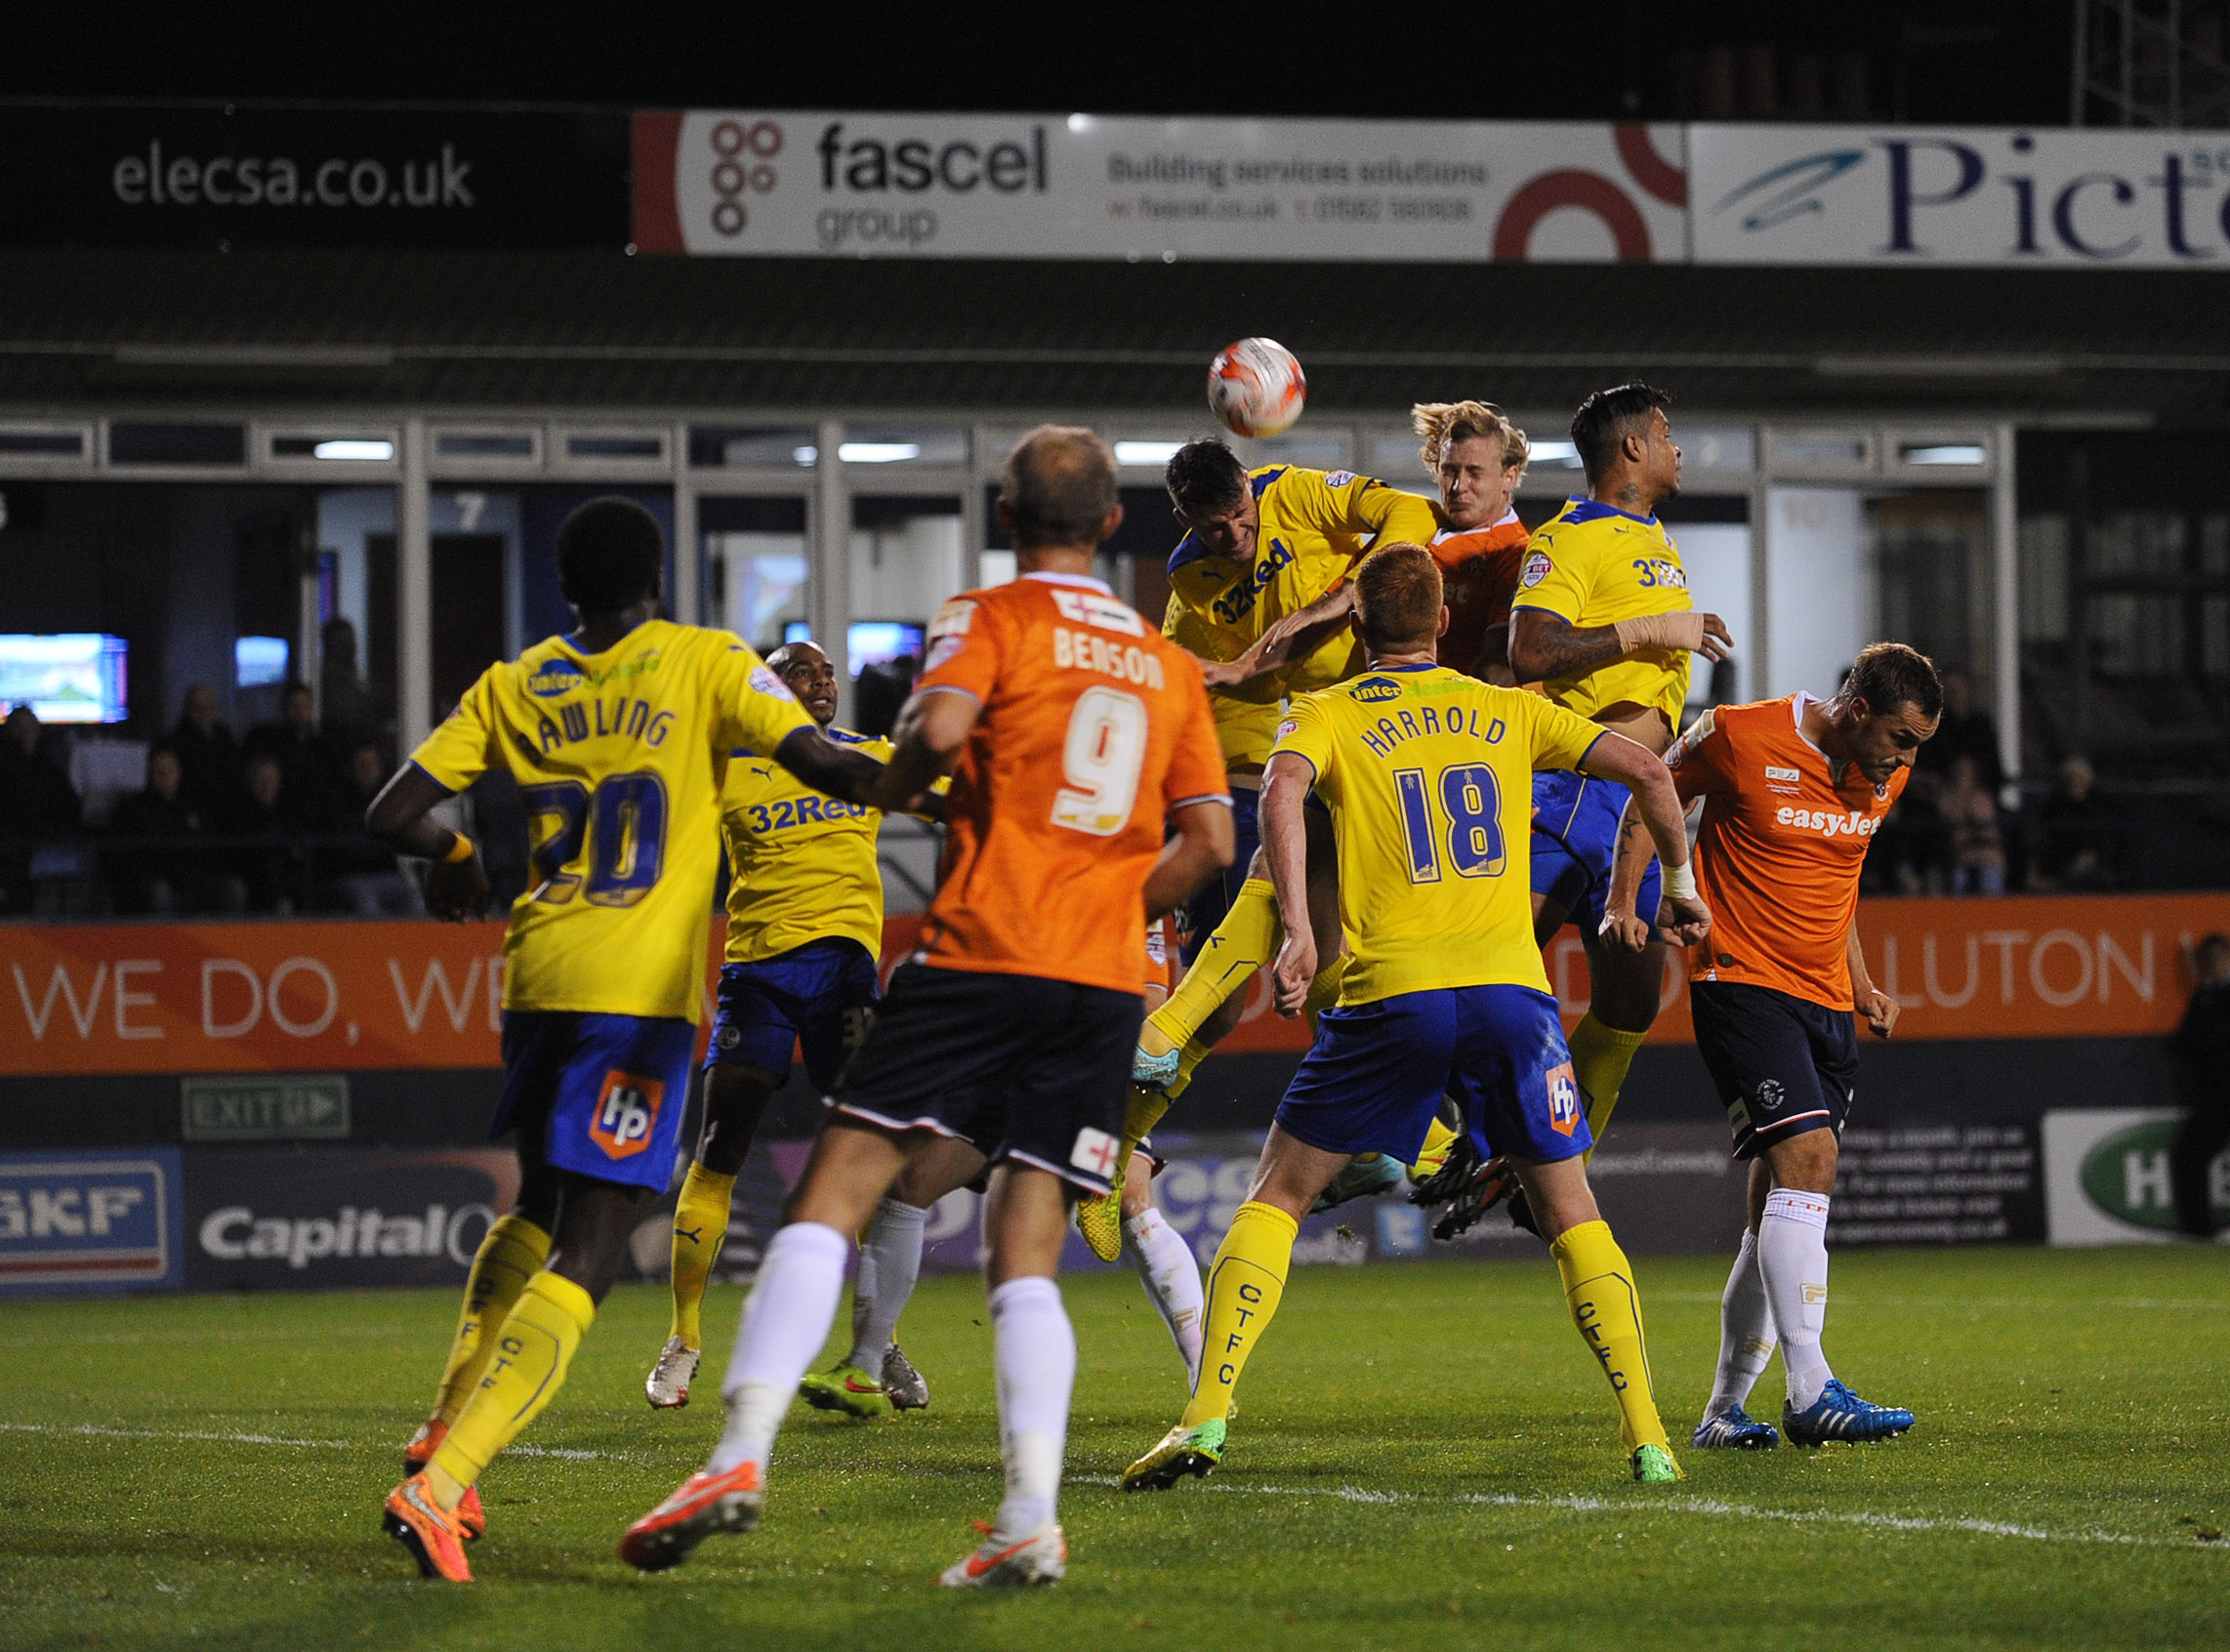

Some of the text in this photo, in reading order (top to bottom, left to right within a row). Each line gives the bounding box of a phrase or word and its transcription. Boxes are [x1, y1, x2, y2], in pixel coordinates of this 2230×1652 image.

[112, 139, 475, 207] elecsa.co.uk
[817, 122, 1049, 192] fascel
[814, 206, 939, 252] group
[1869, 134, 2230, 262] Pict
[1052, 627, 1166, 691] BENSON
[1353, 684, 1403, 701] inter
[1049, 684, 1149, 837] 9
[1360, 706, 1507, 760] HARROLD
[520, 769, 670, 908] 20
[1392, 762, 1507, 885] 18
[1776, 806, 1881, 838] easyJet
[12, 959, 166, 1041] WE
[201, 956, 360, 1046] DO,
[1883, 928, 2155, 1009] LUTON
